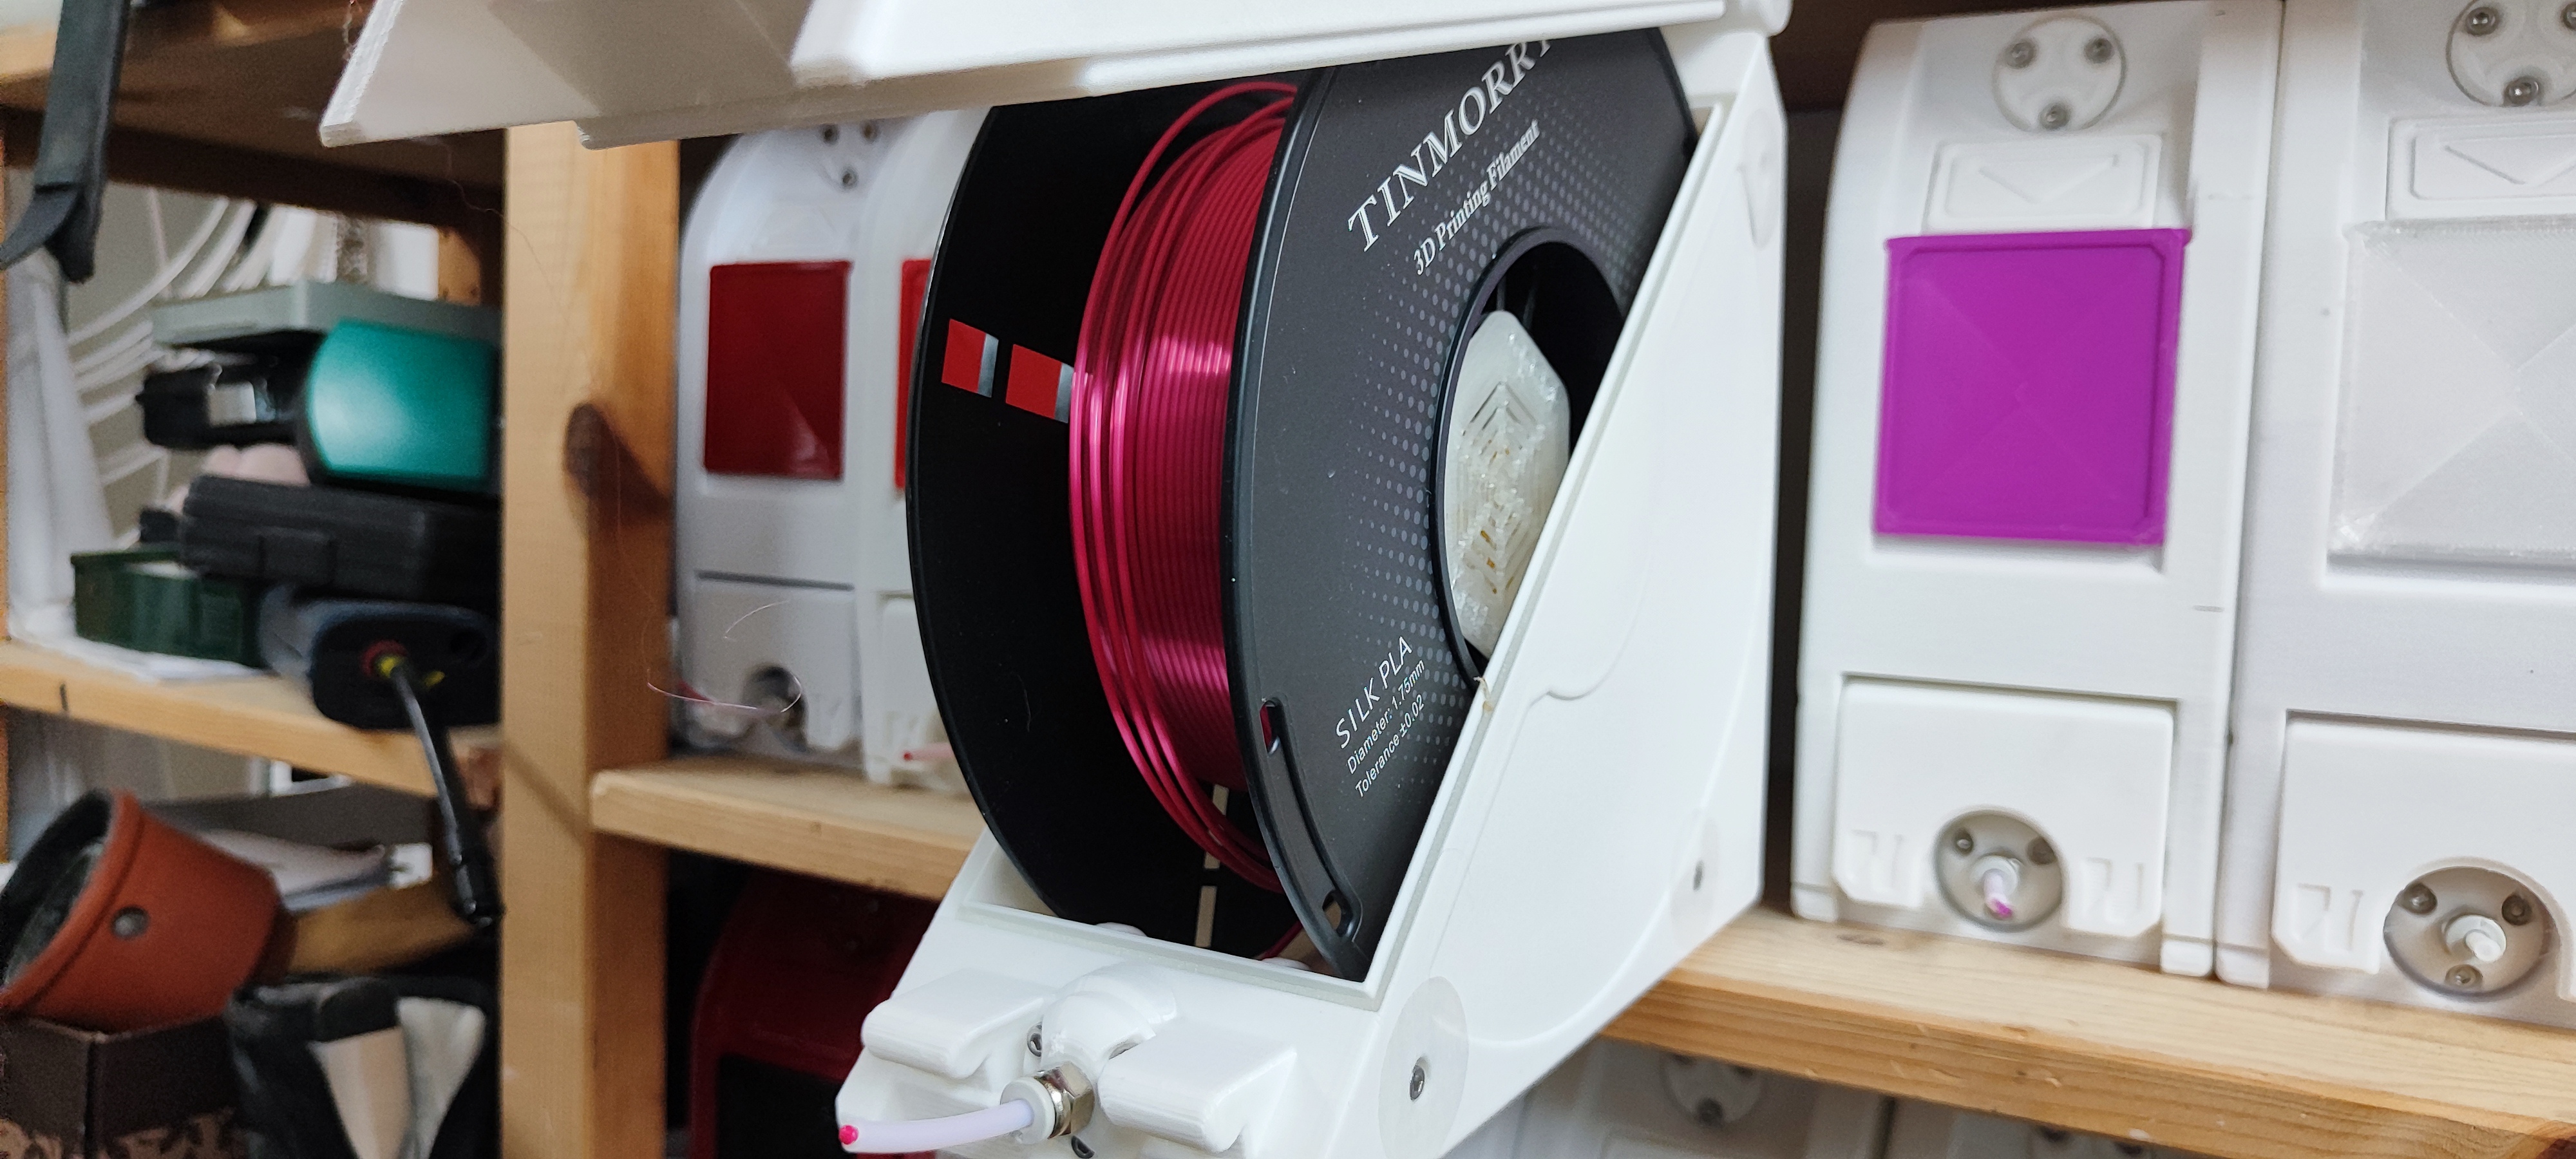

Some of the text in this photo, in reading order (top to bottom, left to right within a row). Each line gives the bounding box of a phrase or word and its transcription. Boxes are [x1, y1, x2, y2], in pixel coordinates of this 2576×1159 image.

[1414, 118, 1540, 276] 3D Printing Filament
[1336, 636, 1412, 749] SILK PLA
[1347, 659, 1425, 775] Diameter: 1.75mm
[1355, 693, 1425, 798] Tolerance ±0.02
